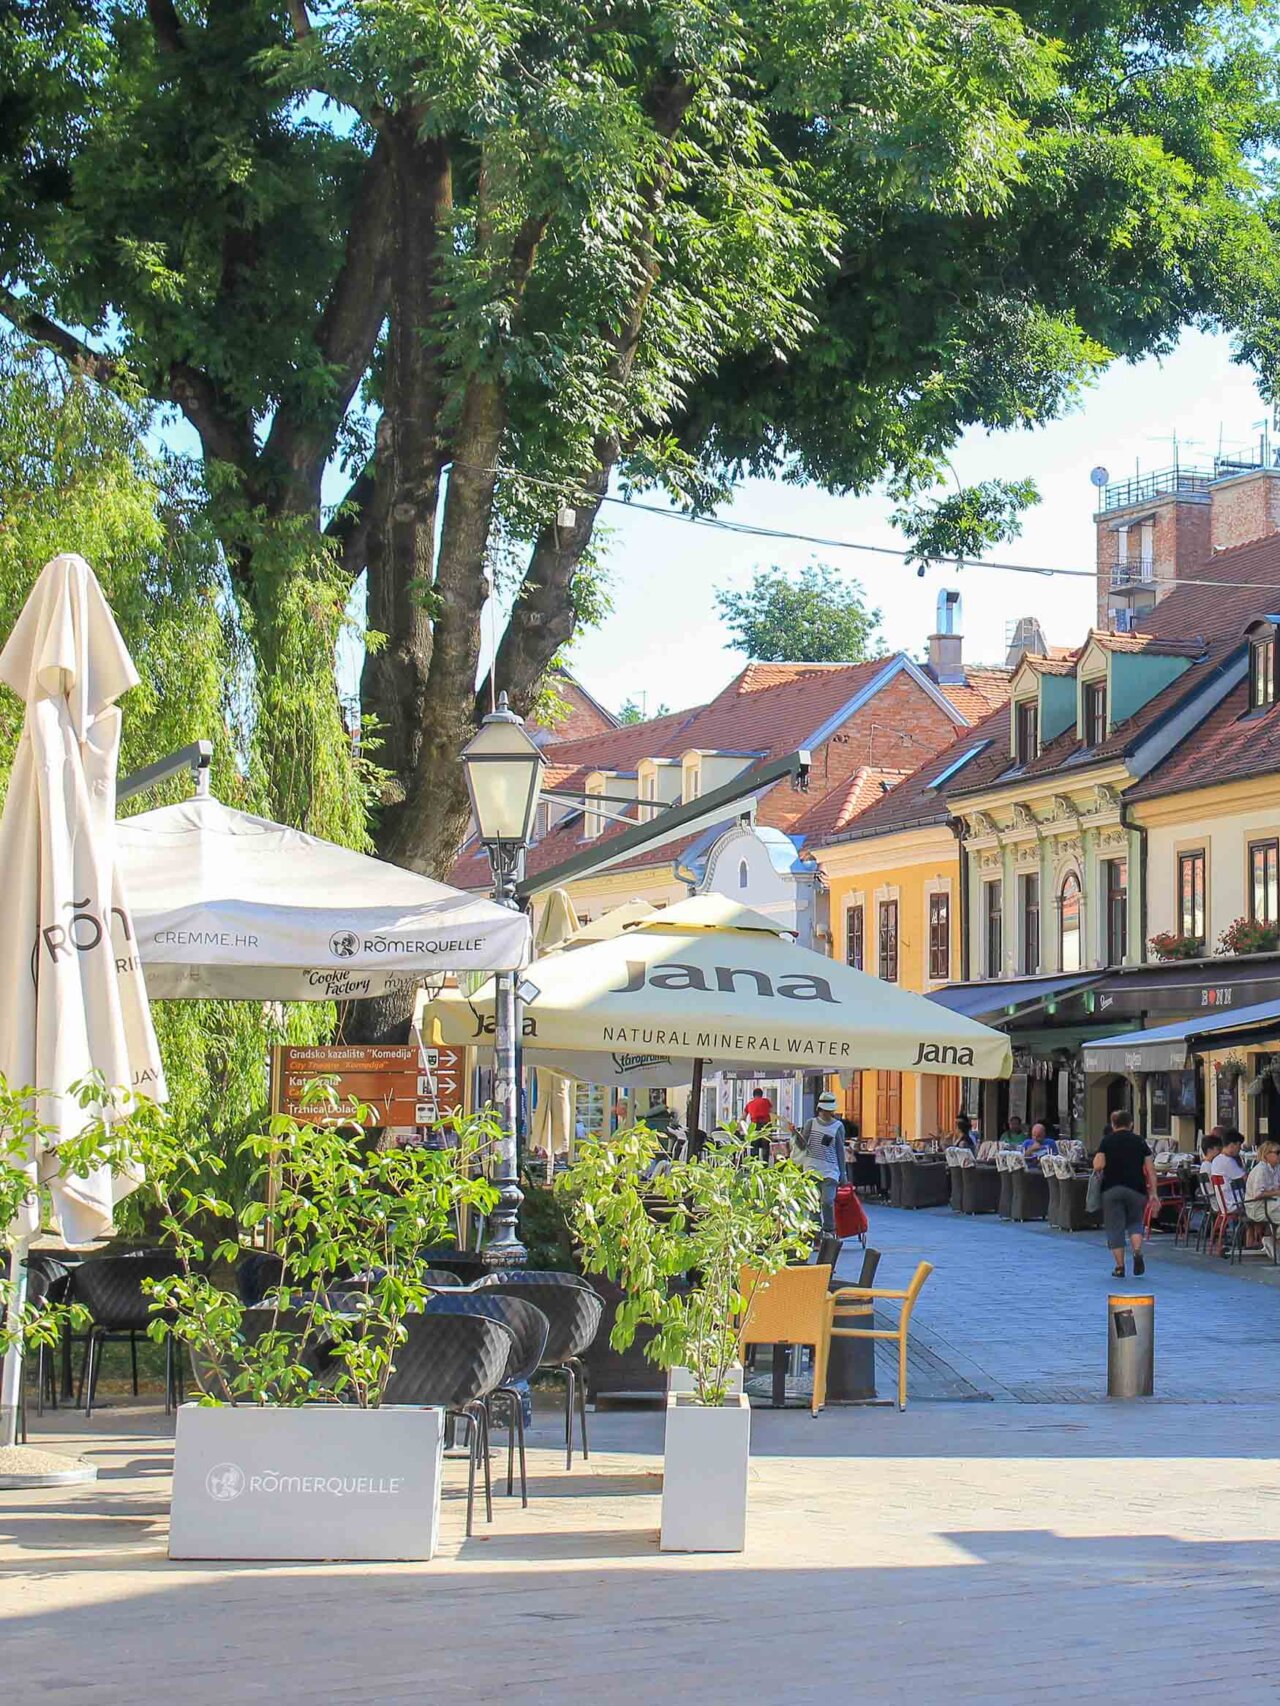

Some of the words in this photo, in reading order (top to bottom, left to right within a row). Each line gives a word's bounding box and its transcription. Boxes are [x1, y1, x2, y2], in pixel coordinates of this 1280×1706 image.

[154, 931, 259, 947] CREMME.HR
[309, 970, 350, 985] Cookie
[325, 979, 370, 996] Factory
[472, 1012, 538, 1038] Jaa
[603, 1027, 690, 1046] NATURAL
[697, 1033, 781, 1052] MINERAL
[787, 1040, 851, 1057] WATER
[290, 1049, 325, 1059] Gradsko
[328, 1049, 365, 1059] kazalište
[288, 1104, 324, 1114] Tržnica
